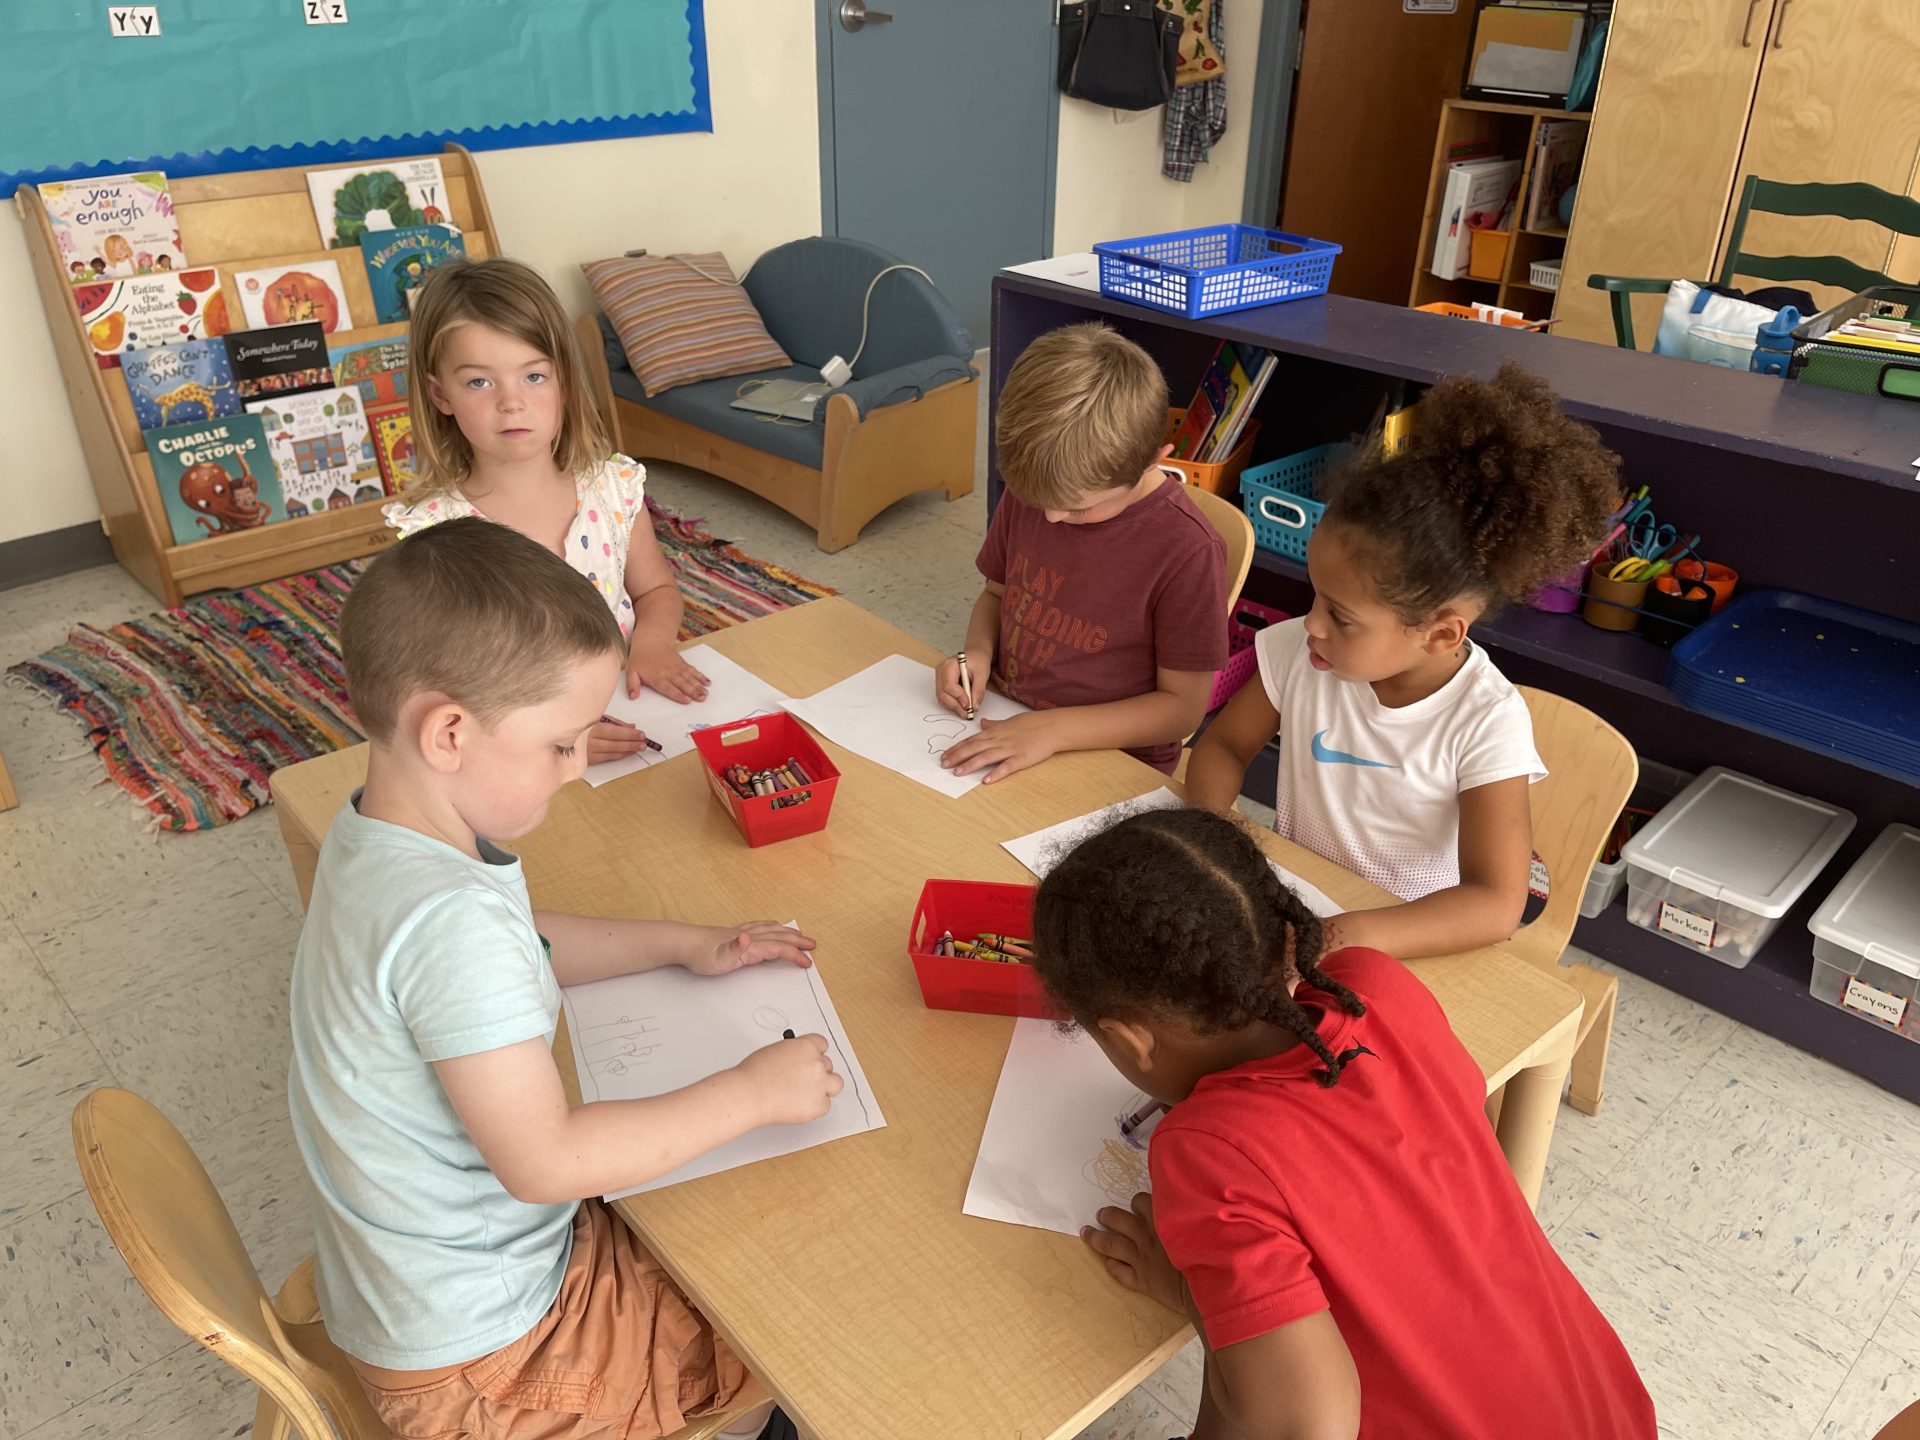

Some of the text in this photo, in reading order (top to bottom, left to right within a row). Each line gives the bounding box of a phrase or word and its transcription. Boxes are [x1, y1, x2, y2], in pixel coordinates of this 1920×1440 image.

[81, 188, 122, 206] you
[98, 200, 117, 210] ARE
[75, 200, 144, 226] enough
[131, 284, 165, 295] Eating
[142, 294, 159, 303] the
[131, 301, 175, 315] Alphabet
[236, 342, 291, 361] Somewhere
[290, 337, 318, 351] Today
[127, 352, 177, 379] GIRAFFES
[149, 364, 196, 386] DANCE
[158, 426, 230, 454] CHARLIE
[180, 437, 256, 467] OCTOPUS
[1005, 584, 1108, 654] READING
[1664, 910, 1710, 937] Markers
[1849, 987, 1899, 1015] Crayons
